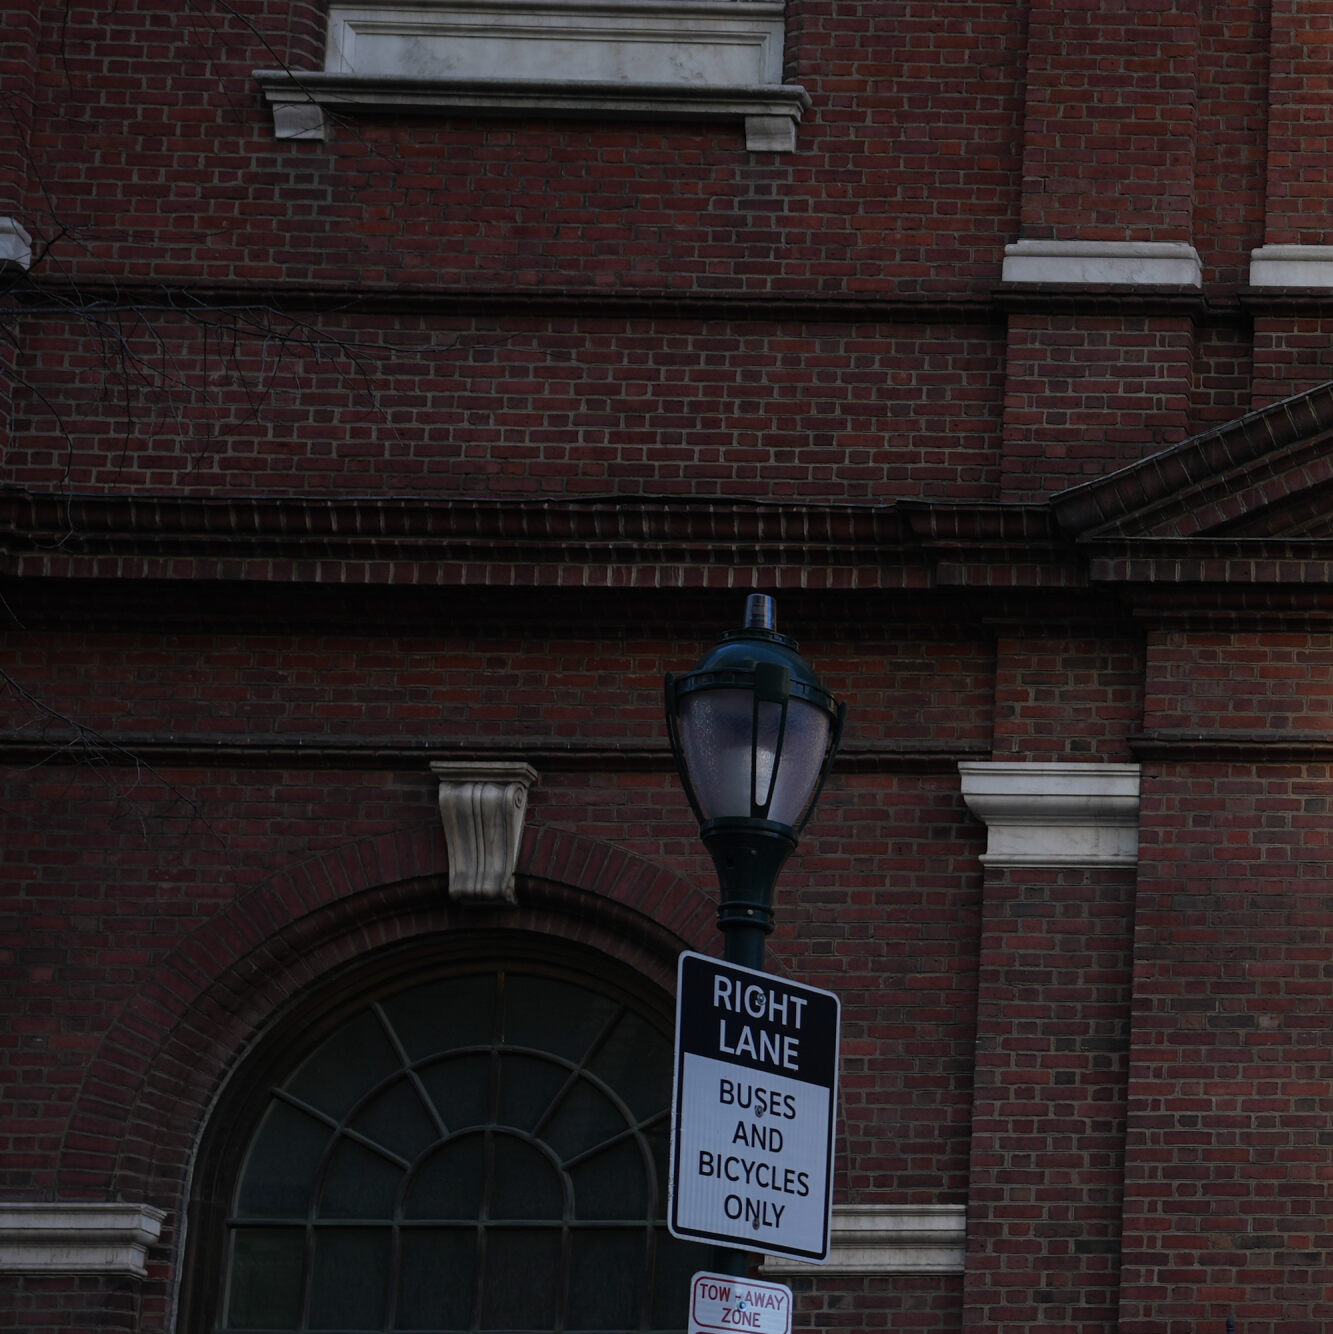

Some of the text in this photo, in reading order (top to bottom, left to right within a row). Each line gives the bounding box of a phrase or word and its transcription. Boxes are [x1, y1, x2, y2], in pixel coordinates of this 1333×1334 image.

[713, 974, 807, 1029] RIGHT
[719, 1019, 799, 1071] LANE
[719, 1079, 796, 1119] BUSES
[732, 1121, 783, 1153] AND
[698, 1150, 809, 1197] BICYCLES
[724, 1194, 785, 1229] ONLY
[721, 1307, 761, 1328] ZONE
